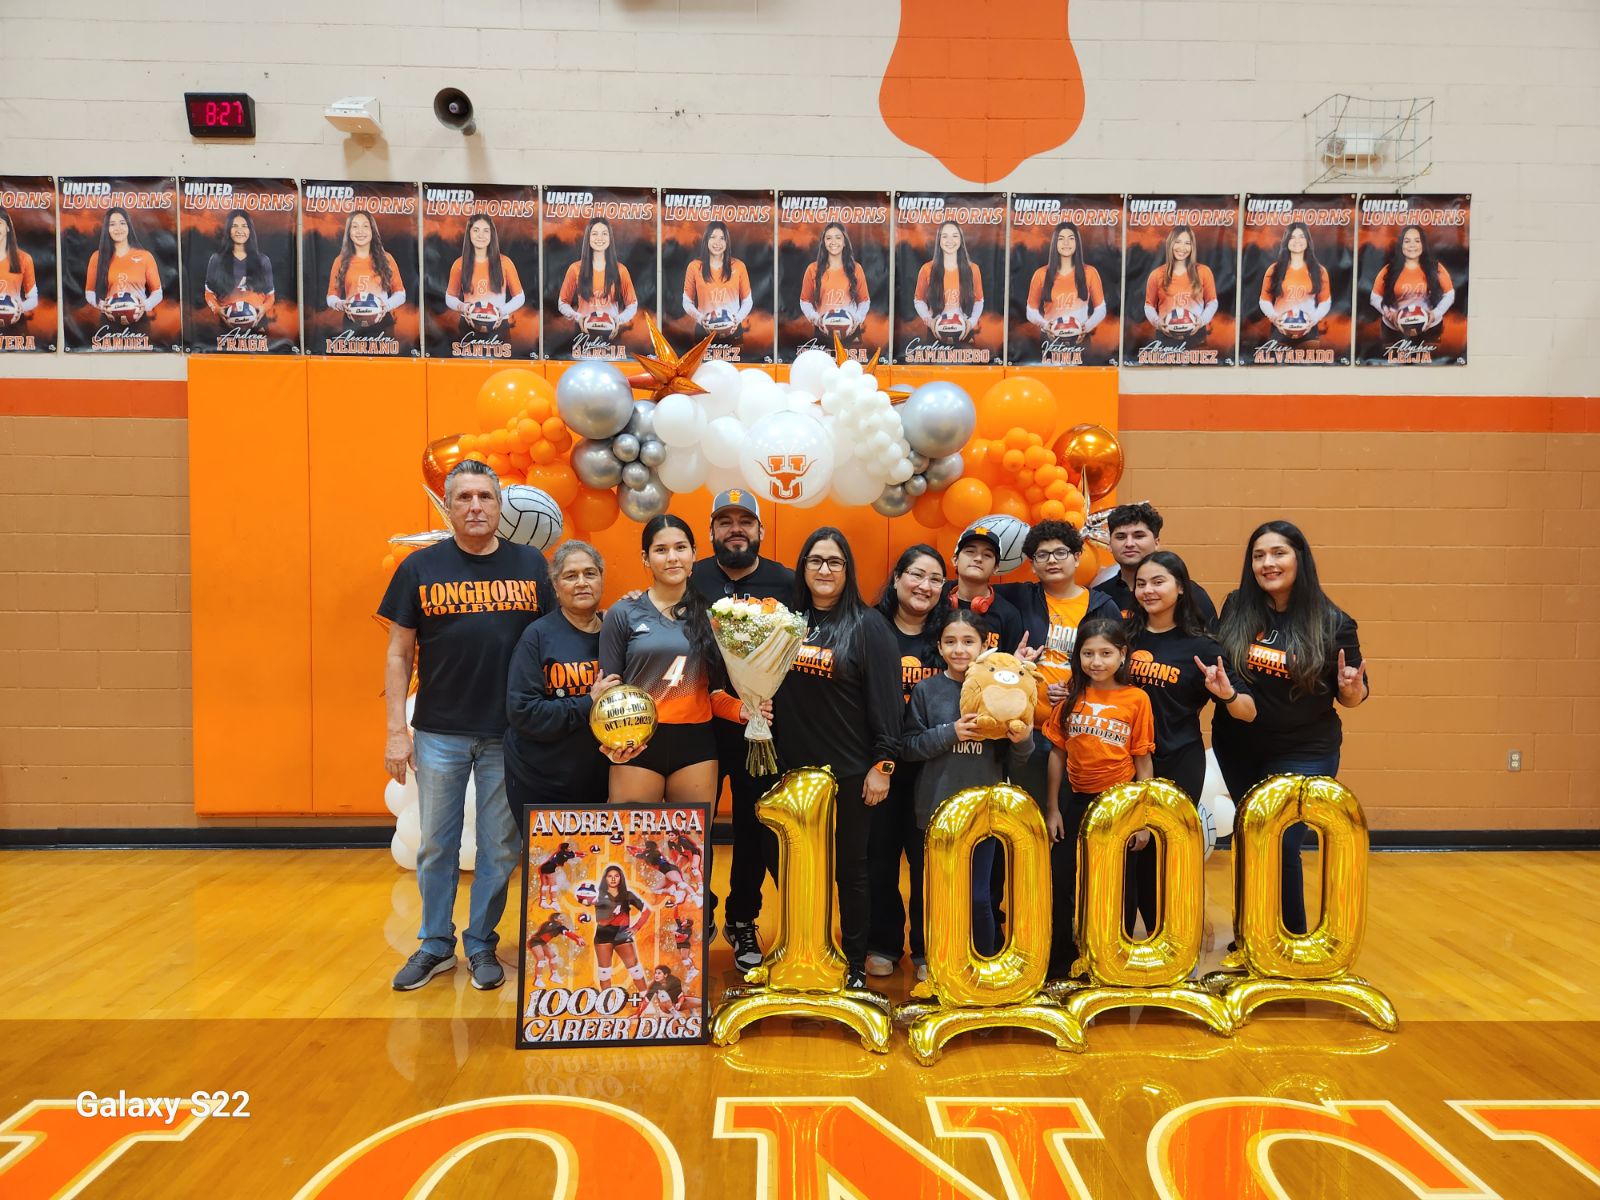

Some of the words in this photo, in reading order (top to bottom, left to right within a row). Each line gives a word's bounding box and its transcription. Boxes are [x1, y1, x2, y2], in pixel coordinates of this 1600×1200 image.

[205, 101, 243, 126] 8:27
[63, 182, 111, 196] UNITED
[184, 182, 232, 196] UNITED
[305, 185, 354, 199] UNITED
[426, 188, 474, 202] UNITED
[546, 191, 594, 204] UNITED
[63, 191, 173, 209] LONGHORNS
[184, 192, 295, 211] LONGHORNS
[305, 196, 415, 214] LONGHORNS
[426, 199, 534, 217] LONGHORNS
[665, 194, 712, 208] UNITED
[781, 196, 828, 210] UNITED
[898, 197, 945, 210] UNITED
[1014, 199, 1061, 212] UNITED
[1129, 199, 1177, 213] UNITED
[1247, 199, 1293, 213] UNITED
[1362, 199, 1408, 213] UNITED
[546, 202, 653, 220] LONGHORNS
[665, 205, 771, 223] LONGHORNS
[781, 206, 887, 224] LONGHORNS
[898, 207, 1003, 225] LONGHORNS
[1013, 208, 1119, 226] LONGHORNS
[1129, 208, 1235, 227] LONGHORNS
[1246, 208, 1352, 226] LONGHORNS
[1362, 208, 1466, 226] LONGHORNS
[357, 275, 370, 292] 5
[477, 279, 488, 295] 8
[94, 324, 146, 342] Carolina
[218, 326, 266, 345] Andrea
[461, 331, 503, 348] Camila
[216, 336, 268, 351] FRAGA
[325, 338, 399, 354] MEDRANO
[452, 341, 512, 358] SANTOS
[905, 337, 955, 356] Carolina
[1041, 336, 1085, 357] Victoria
[703, 347, 741, 361] EREZ
[905, 349, 990, 363] SAMANIEGO
[1041, 350, 1083, 365] LUNA
[1138, 350, 1219, 364] RODRIGUEZ
[1254, 349, 1335, 363] ALVARADO
[418, 579, 538, 609] LONGHORNS
[662, 655, 688, 687] 4
[604, 719, 622, 732] OCT.
[1067, 713, 1131, 736] NITED
[532, 810, 625, 836] ANDREA
[629, 809, 704, 836] FRAGA
[612, 903, 621, 915] 4
[523, 1016, 631, 1042] CAREER
[635, 1016, 703, 1040] DIGS
